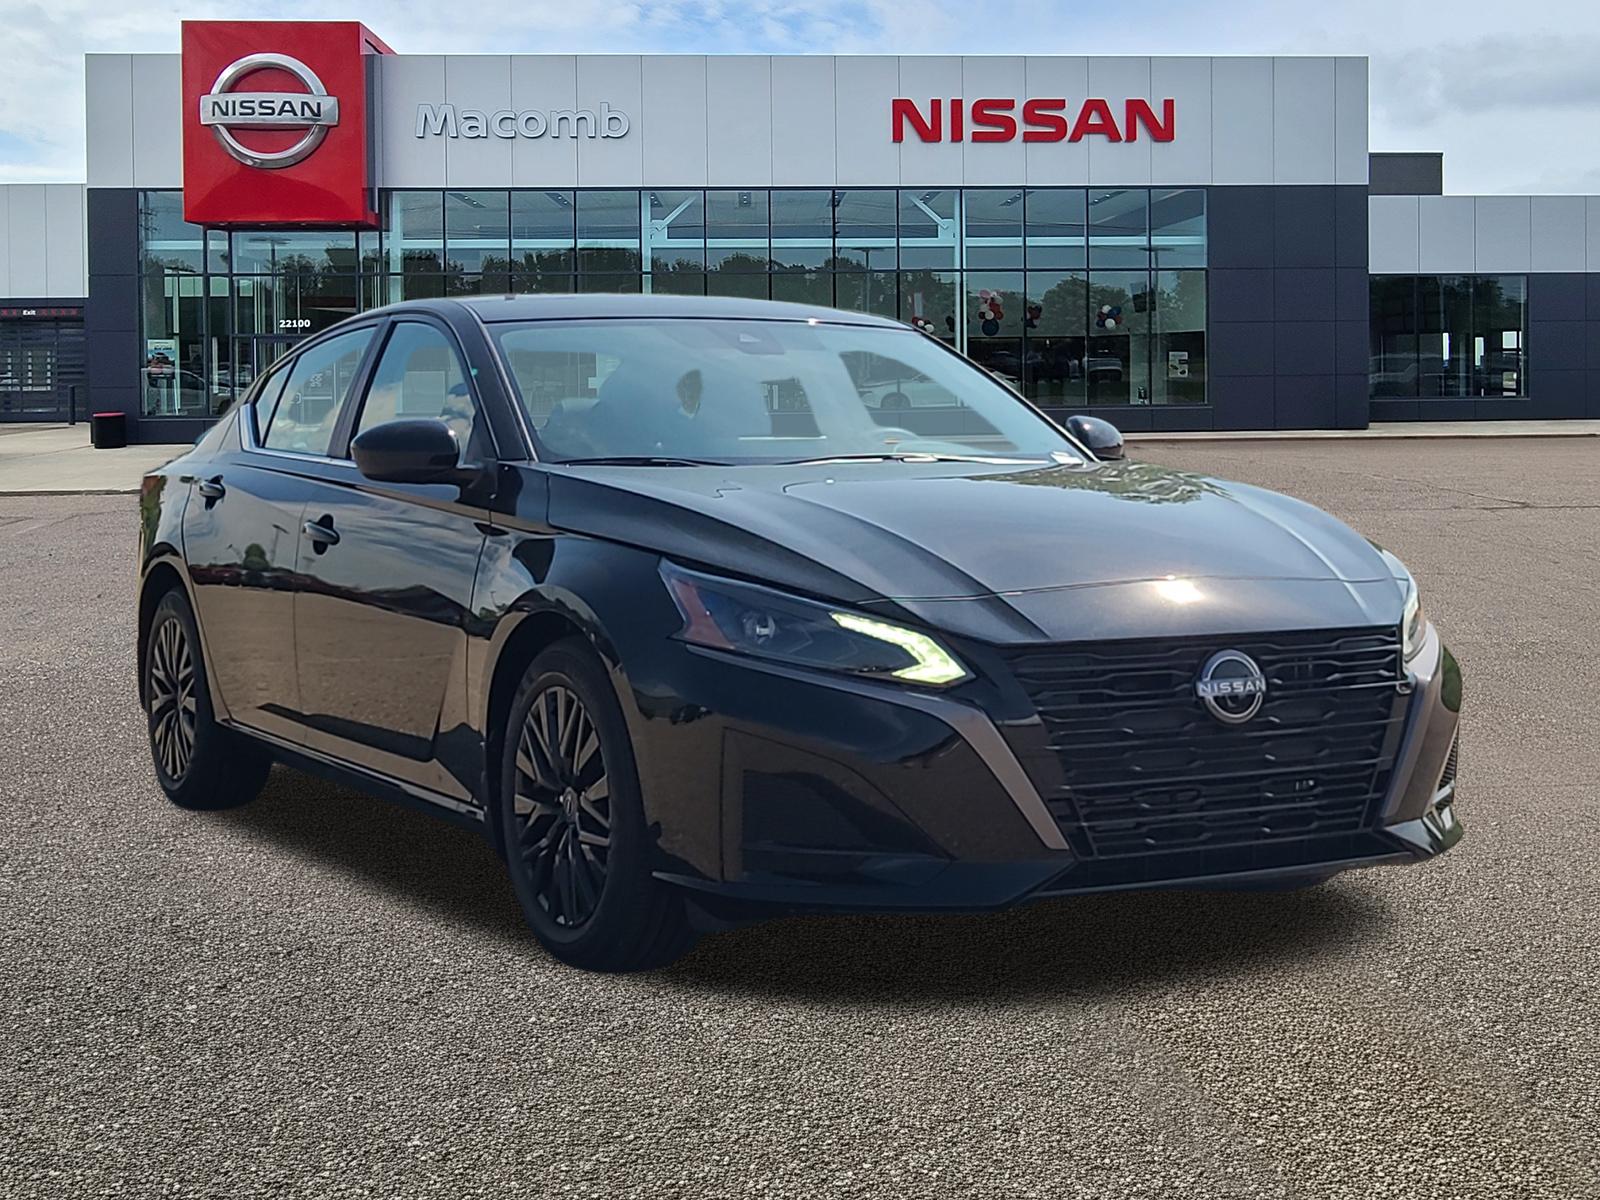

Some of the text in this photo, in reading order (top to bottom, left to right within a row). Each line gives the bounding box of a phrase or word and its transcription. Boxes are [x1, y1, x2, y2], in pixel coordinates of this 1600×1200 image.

[211, 100, 322, 118] NISSAN
[415, 102, 630, 138] Macomb
[892, 98, 1175, 143] NISSAN
[279, 319, 311, 328] 22100
[1199, 680, 1266, 694] NISSAN
